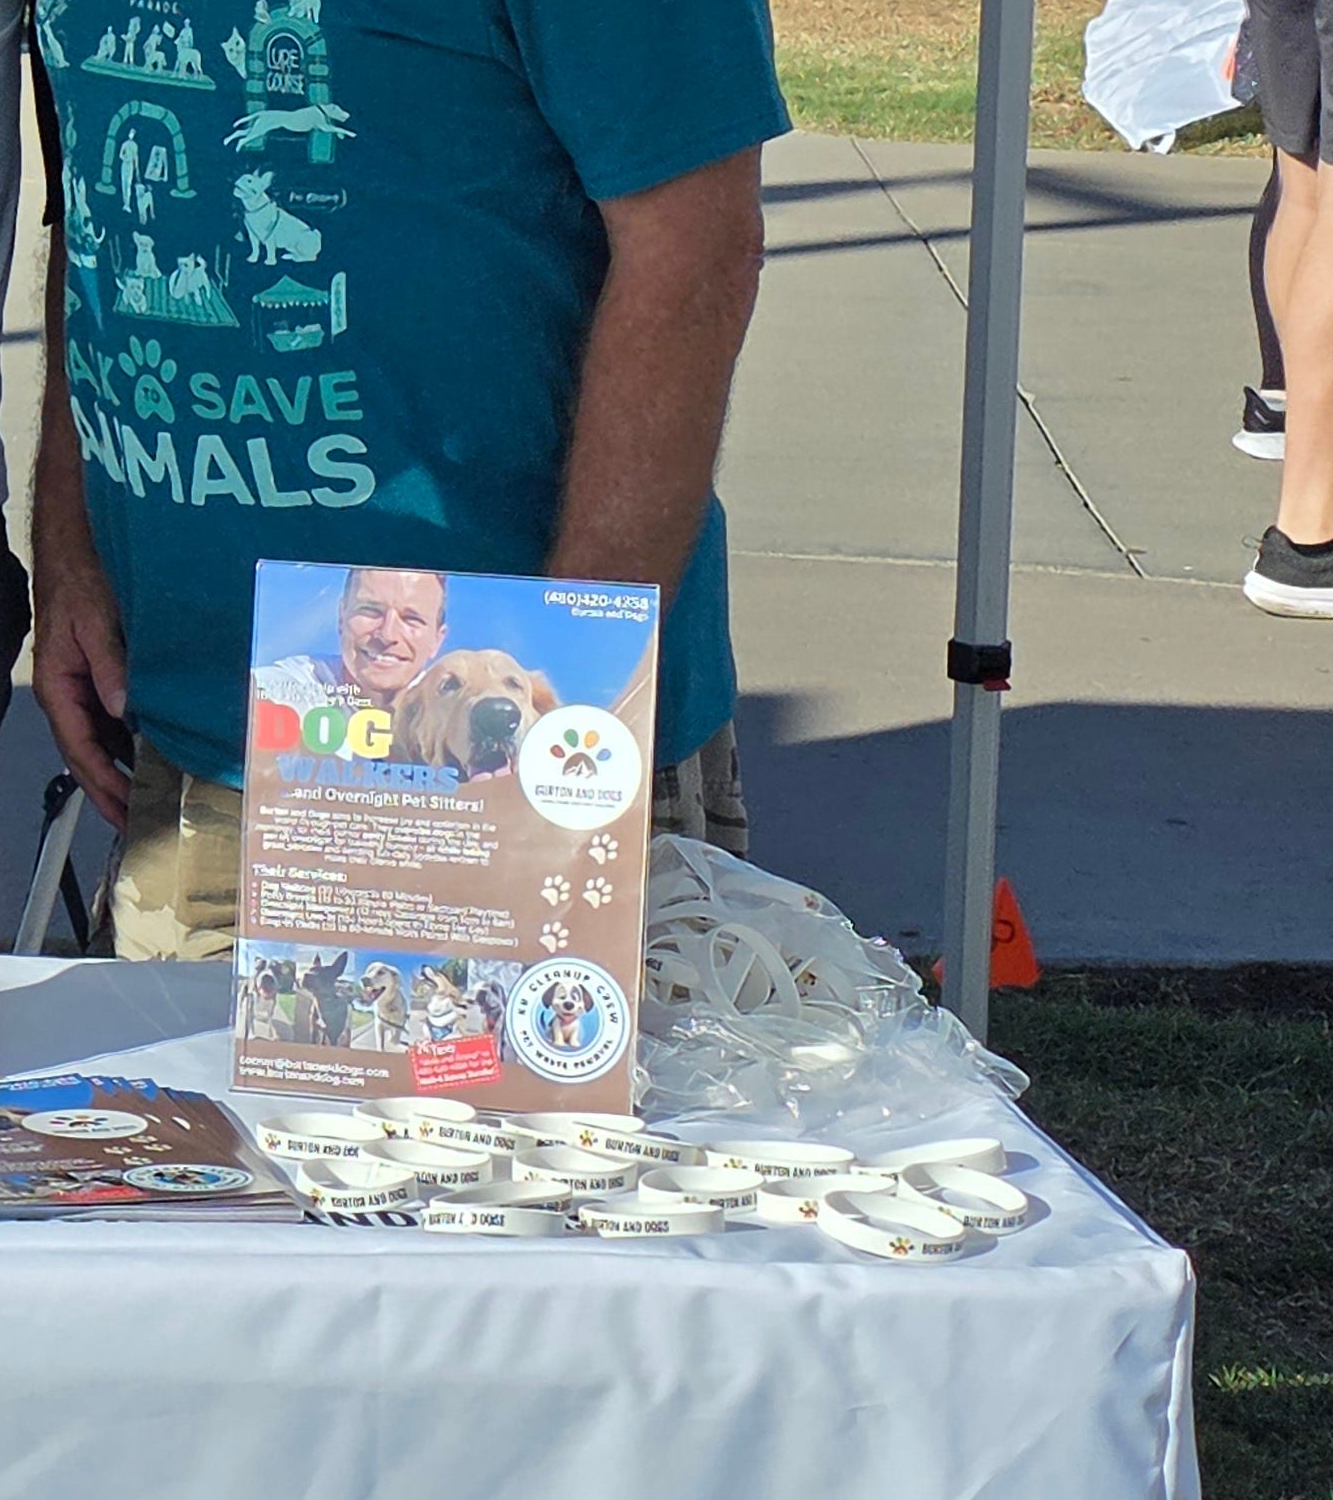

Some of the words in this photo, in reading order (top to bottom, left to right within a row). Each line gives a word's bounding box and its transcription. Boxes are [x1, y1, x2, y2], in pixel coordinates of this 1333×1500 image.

[188, 369, 364, 426] SAVE
[256, 702, 393, 759] DOG
[278, 756, 459, 794] WALKERS
[325, 786, 399, 809] Overnight
[401, 792, 428, 808] Pet
[429, 794, 484, 813] Sitters!
[535, 785, 573, 798] BURTON
[575, 787, 596, 799] AND
[598, 788, 623, 802] DOGS
[472, 1133, 492, 1146] AND
